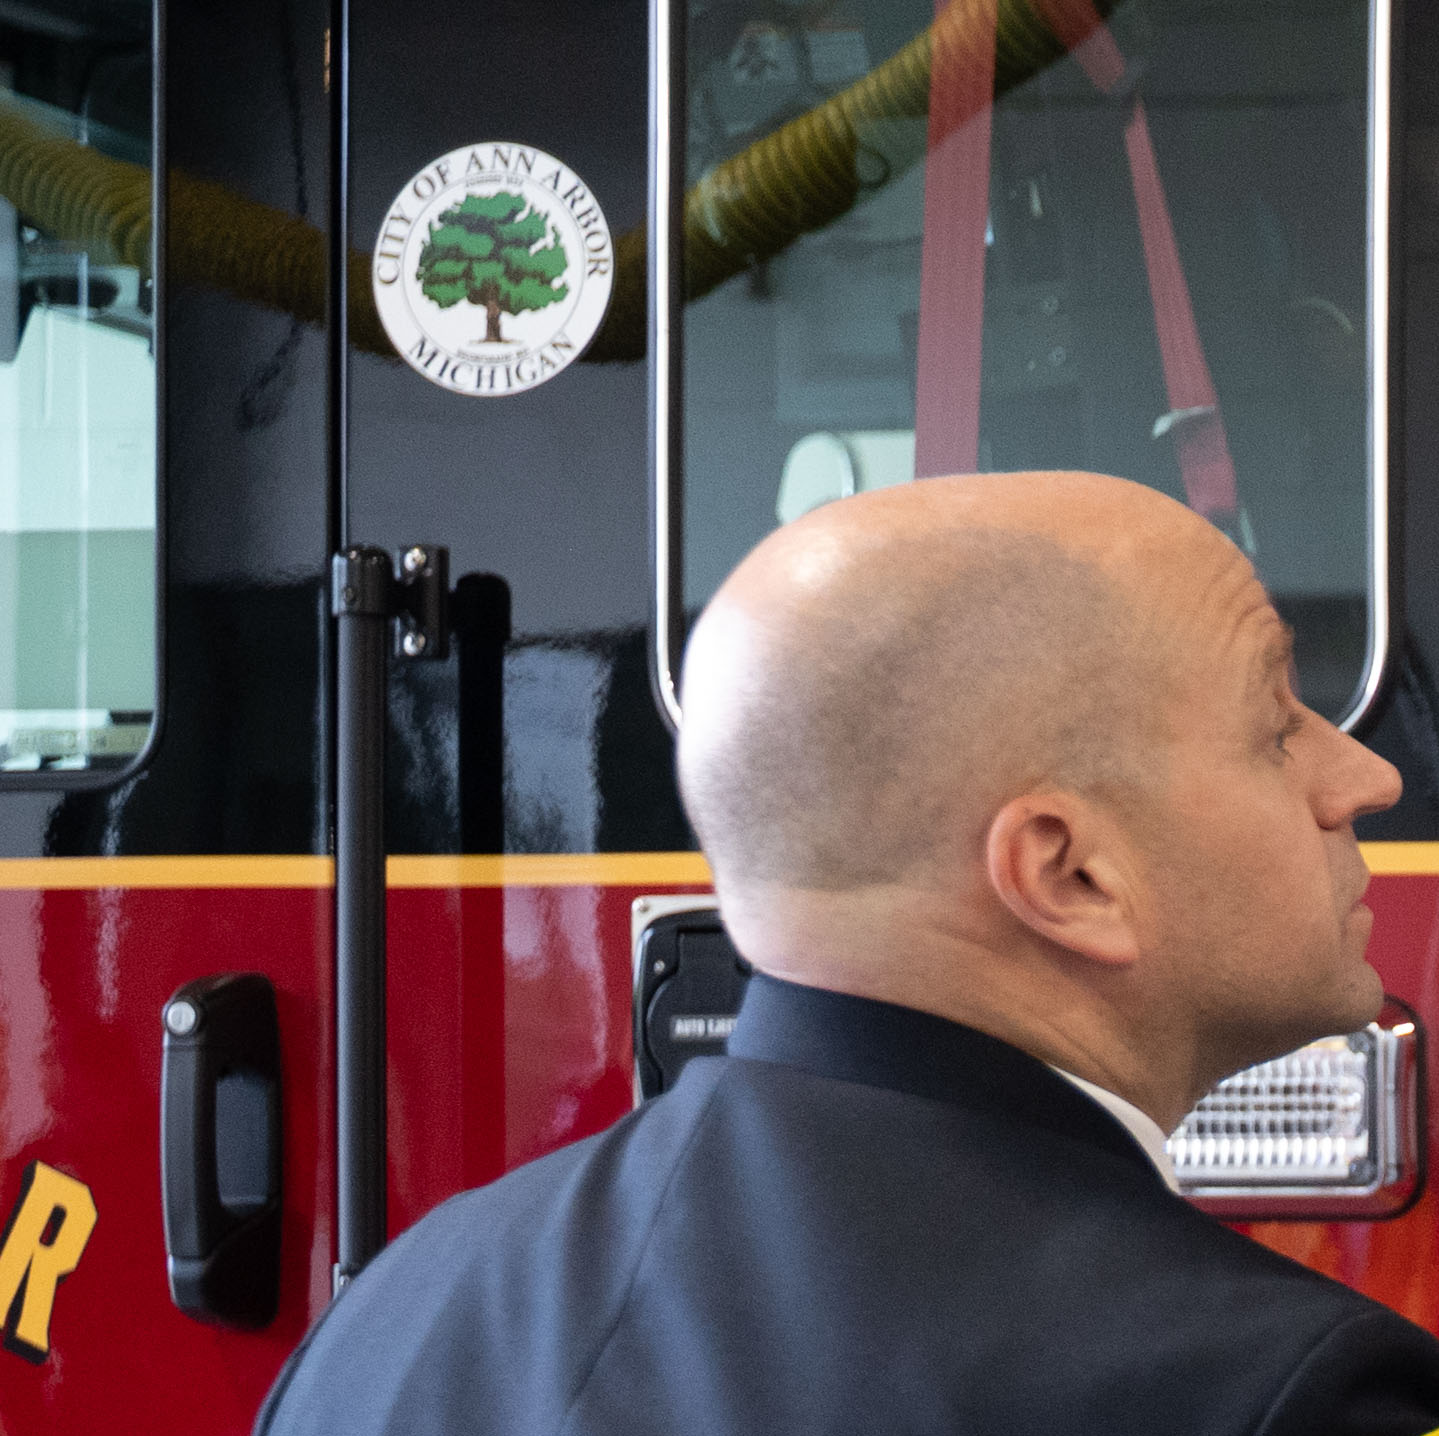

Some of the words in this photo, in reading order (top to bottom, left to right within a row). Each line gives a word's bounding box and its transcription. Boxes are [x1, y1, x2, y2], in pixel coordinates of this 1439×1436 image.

[377, 201, 412, 285] CITY
[412, 162, 452, 201] OF
[465, 145, 538, 175] ANN
[541, 168, 610, 279] ARBOR
[408, 331, 577, 389] MICHIGAN
